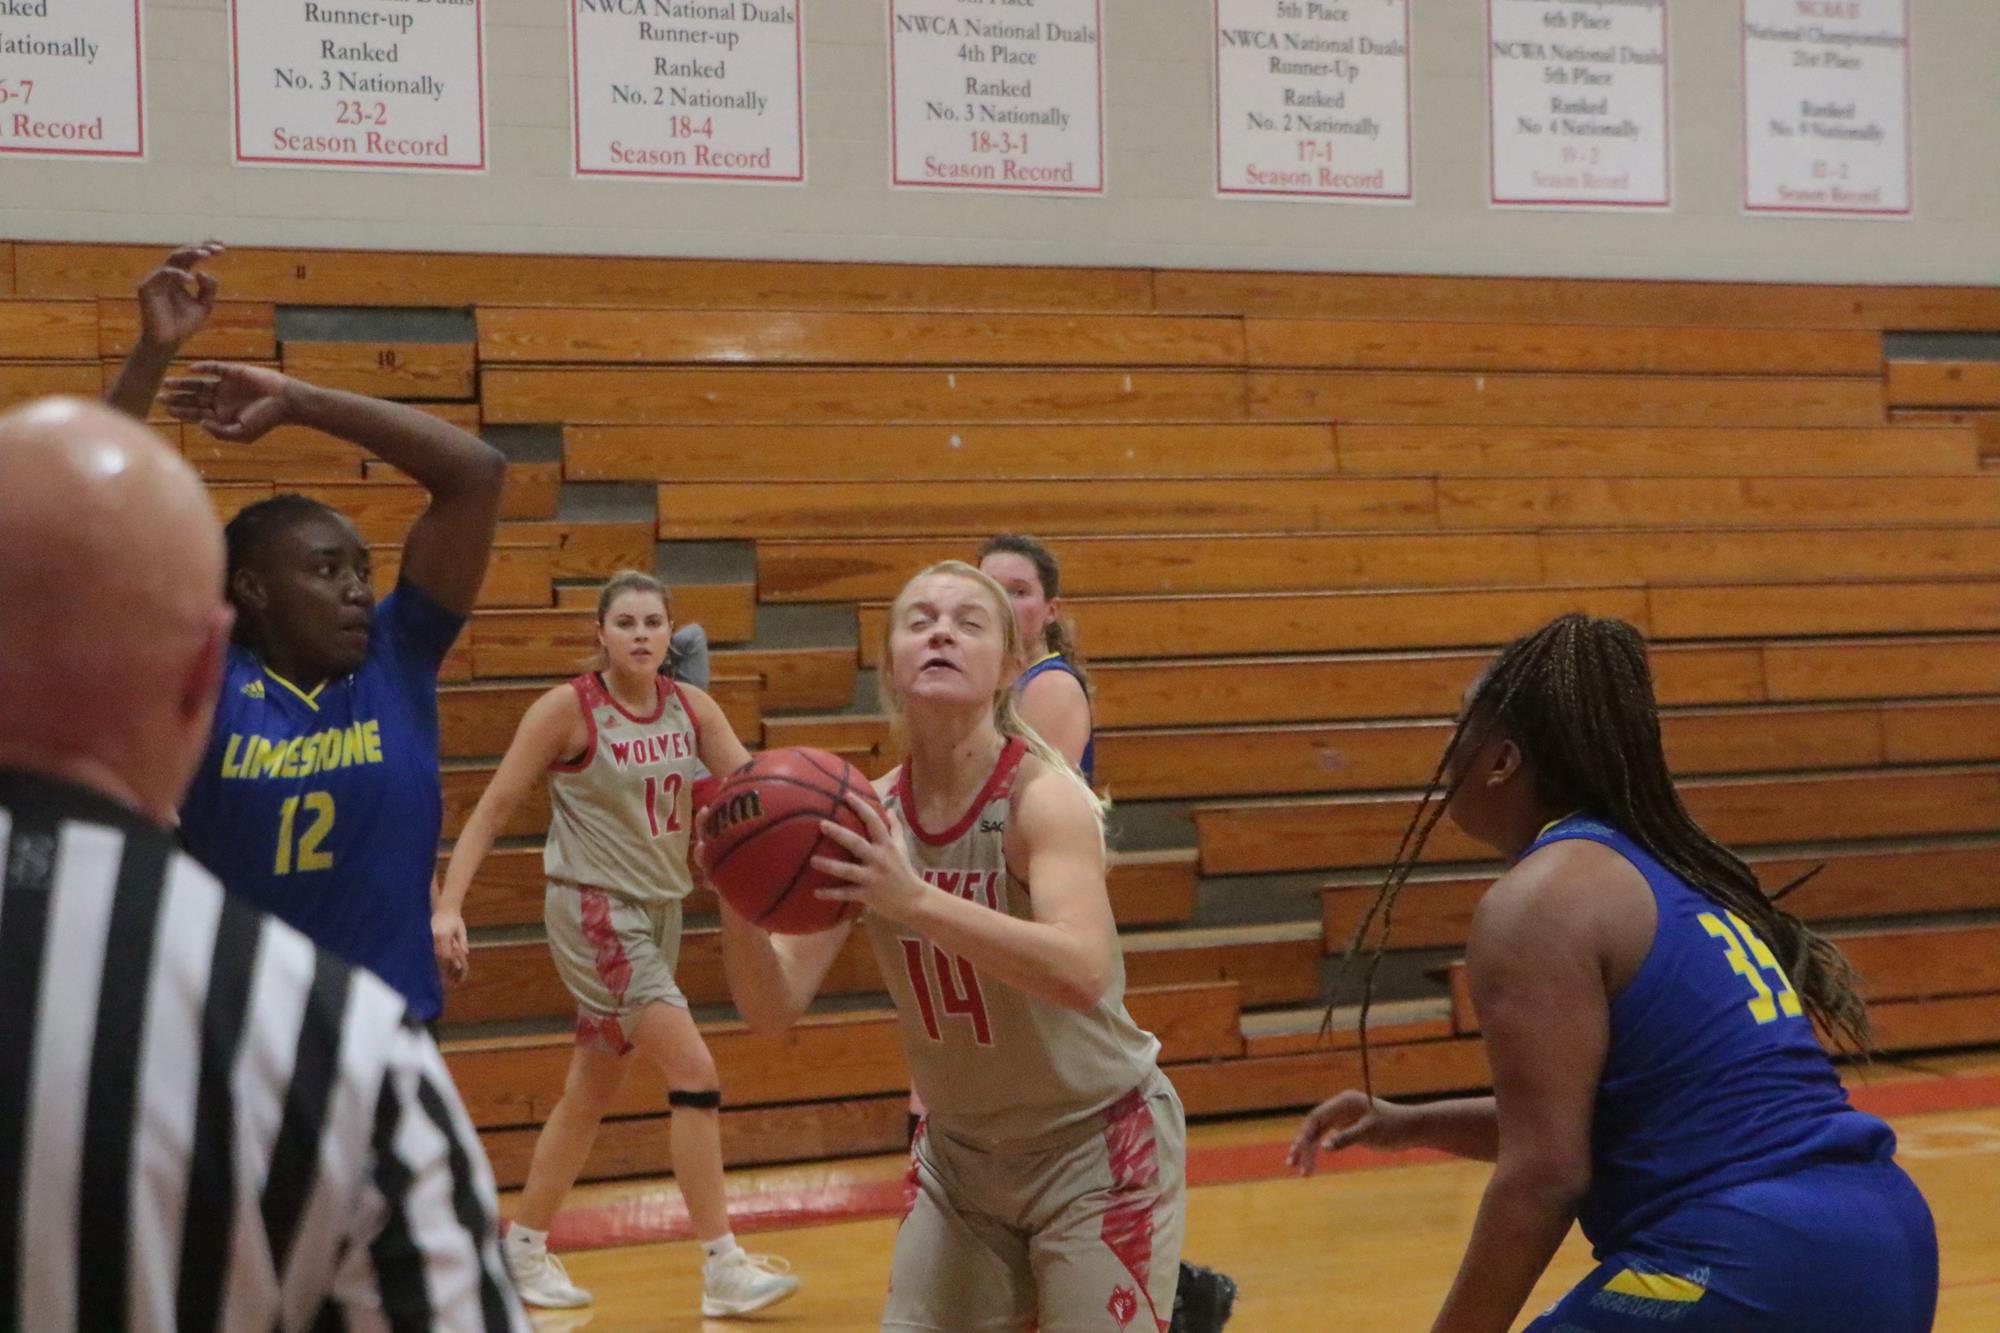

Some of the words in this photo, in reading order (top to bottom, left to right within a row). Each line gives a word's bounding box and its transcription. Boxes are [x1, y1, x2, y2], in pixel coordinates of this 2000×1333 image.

[304, 2, 414, 34] Runner-up
[654, 0, 736, 21] National
[742, 3, 795, 24] Duals
[1276, 0, 1302, 20] 5th
[1307, 2, 1349, 22] Place
[1571, 11, 1612, 31] Place
[638, 20, 740, 51] Runner-up
[896, 14, 959, 37] NWCA
[964, 18, 1041, 41] National
[1046, 23, 1096, 43] Duals
[320, 39, 400, 63] Ranked
[958, 43, 985, 64] 4th
[991, 45, 1037, 66] Place
[1221, 29, 1279, 50] NWCA
[1283, 33, 1354, 55] National
[654, 56, 726, 80] Ranked
[1269, 55, 1360, 84] Runner-Up
[1572, 67, 1613, 87] Place
[274, 67, 313, 90] No.
[319, 69, 332, 91] 3
[338, 70, 446, 102] Nationally
[965, 76, 1032, 98] Ranked
[610, 84, 648, 106] No.
[653, 86, 664, 106] 2
[670, 86, 768, 116] Nationally
[1284, 88, 1345, 110] Ranked
[1551, 97, 1609, 116] Ranked
[335, 100, 388, 126] 23-2
[926, 101, 960, 122] No.
[963, 103, 975, 123] 3
[979, 104, 1071, 132] Nationally
[12, 112, 104, 141] Record
[668, 115, 714, 140] 18-4
[1283, 114, 1293, 132] 2
[1297, 115, 1381, 140] Nationally
[273, 126, 357, 155] Season
[366, 130, 449, 157] Record
[610, 140, 687, 166] Season
[695, 143, 771, 169] Record
[969, 129, 1029, 155] 18-3-1
[1297, 140, 1334, 163] 17-1
[924, 156, 995, 180] Season
[1002, 159, 1073, 183] Record
[1246, 164, 1312, 187] Season
[1319, 167, 1384, 190] Record
[610, 730, 693, 770] WOLVES
[642, 772, 684, 838] 12
[274, 790, 335, 876] 12
[1696, 908, 1804, 1026] 35
[901, 936, 994, 1048] 14
